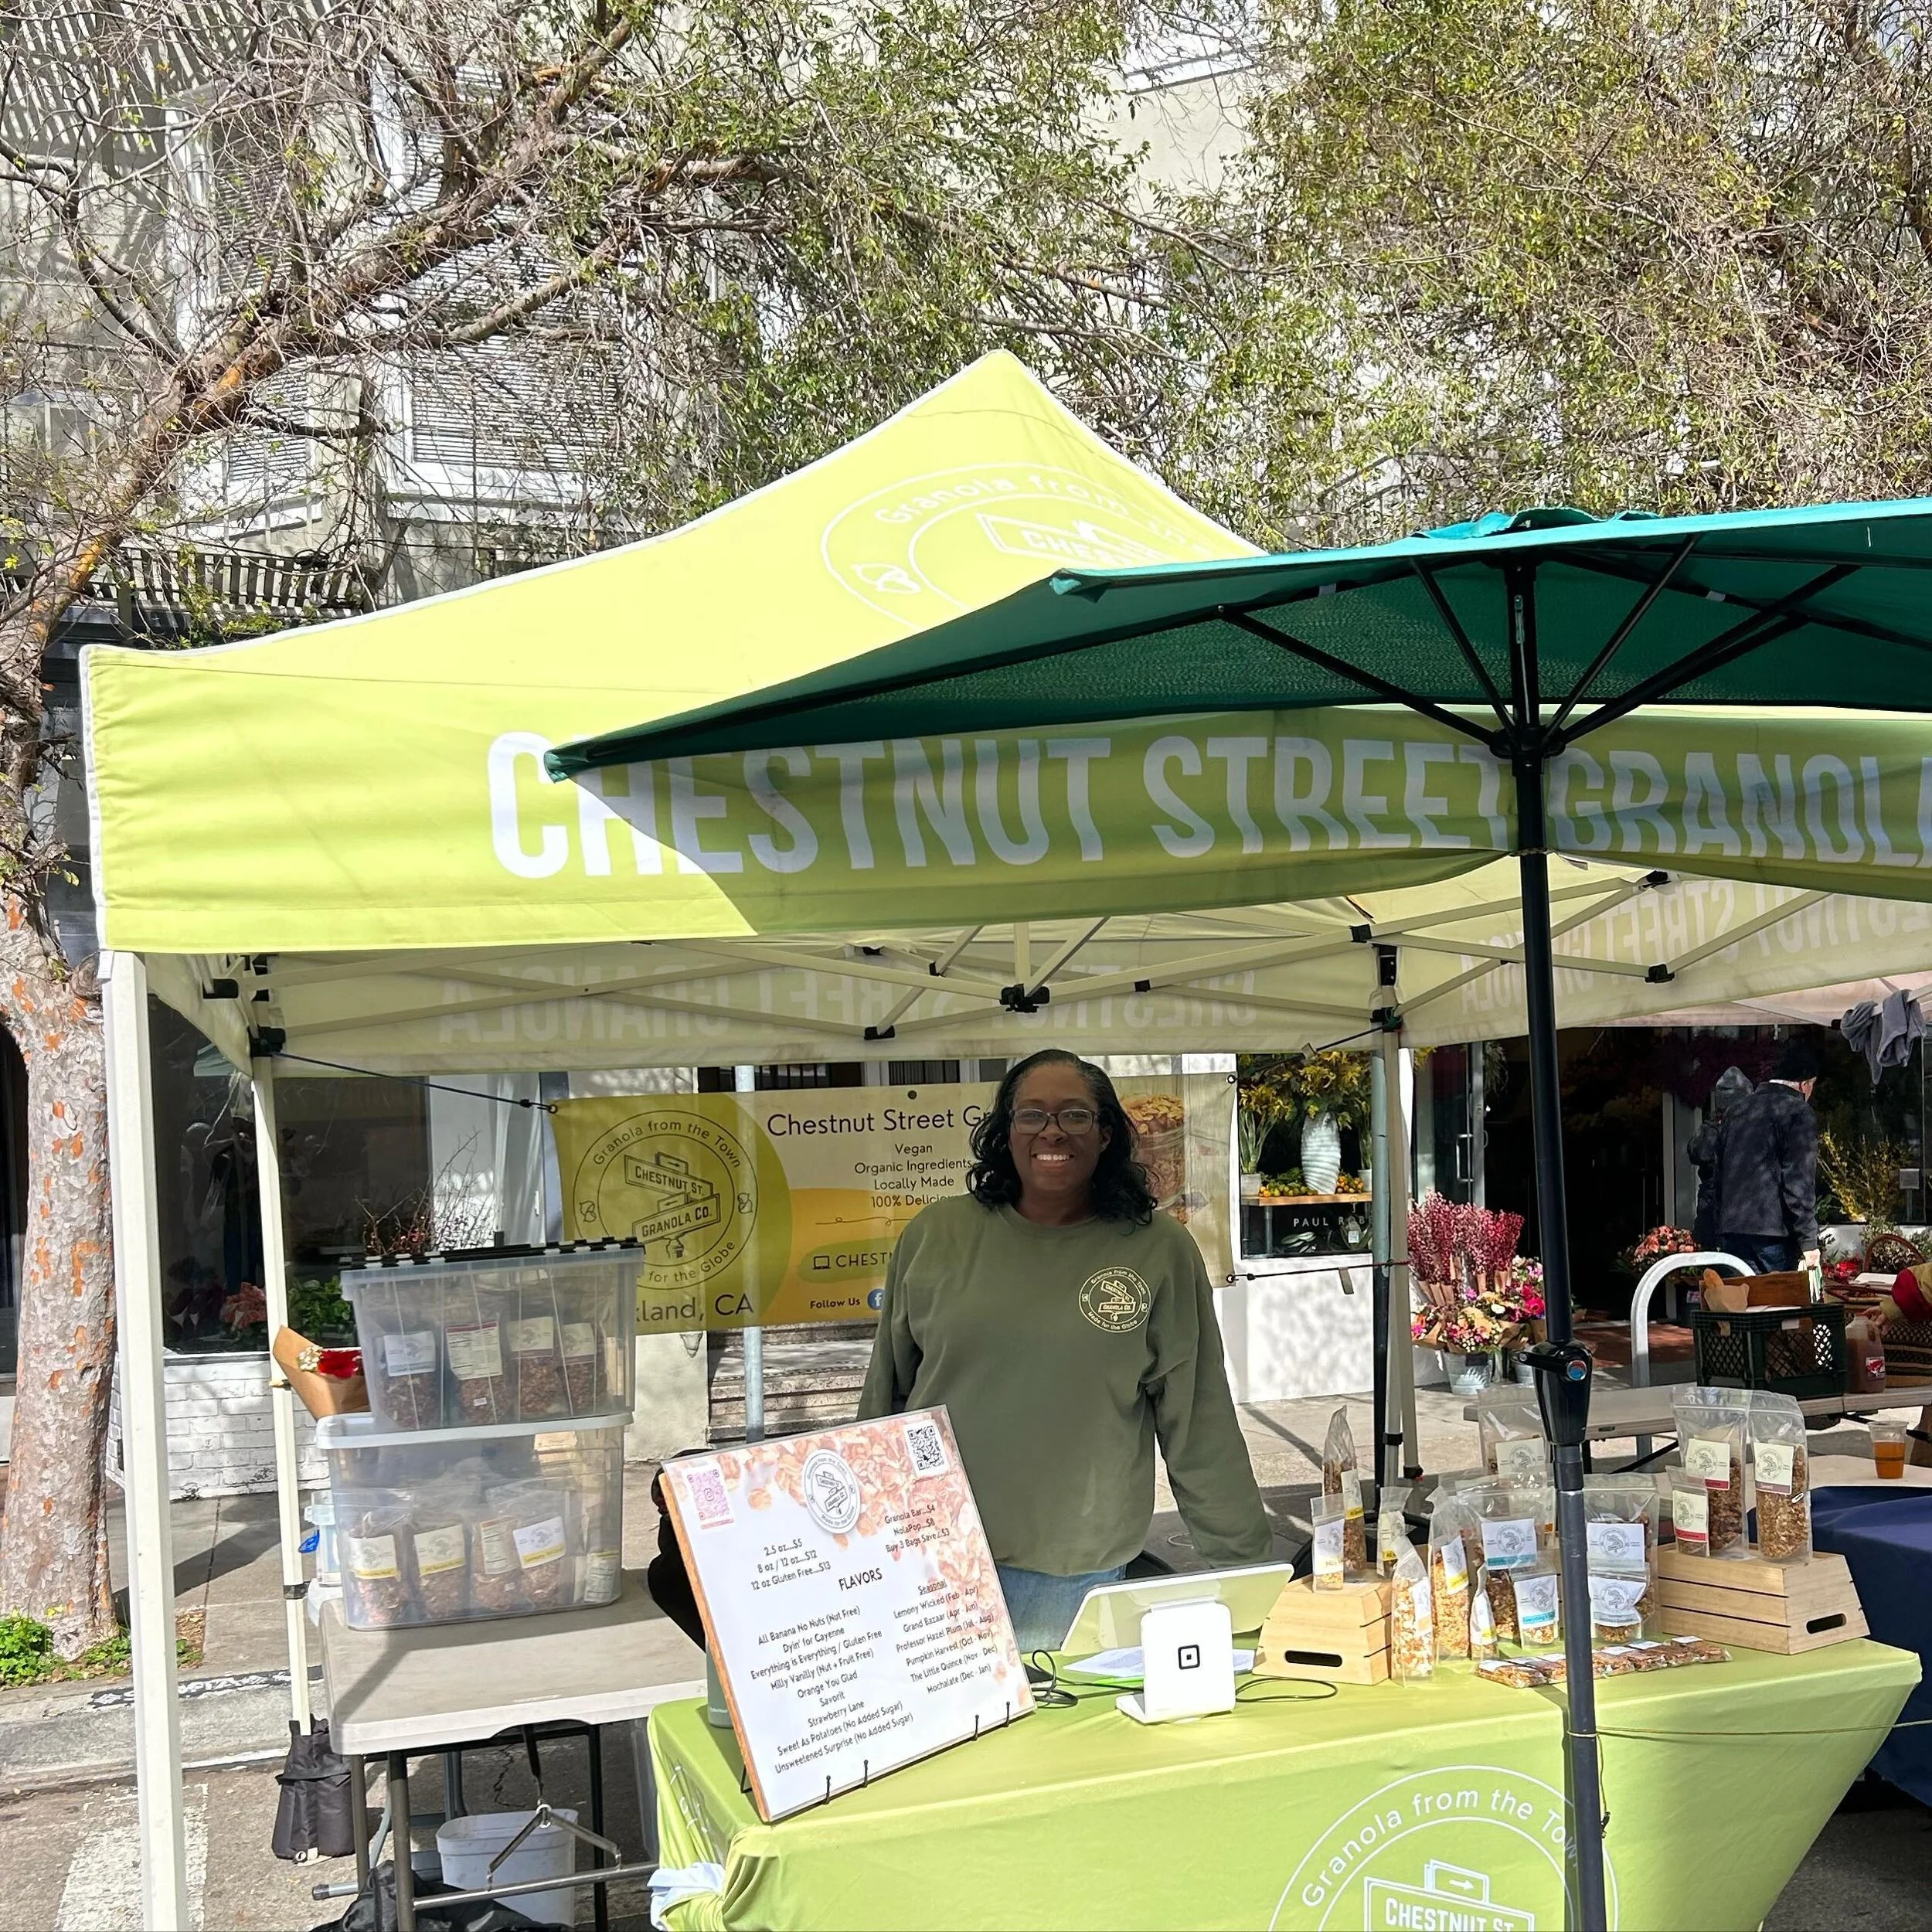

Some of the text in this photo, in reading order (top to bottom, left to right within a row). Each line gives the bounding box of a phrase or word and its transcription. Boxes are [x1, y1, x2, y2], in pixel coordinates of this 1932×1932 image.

[875, 474, 1129, 525] Granola from
[488, 731, 1111, 879] CHESTNUT
[1143, 736, 1515, 859] STREET
[767, 1113, 875, 1137] Chestnut
[884, 1108, 954, 1131] Street
[594, 1121, 741, 1168] Granola from the Town
[895, 1143, 933, 1157] Vegan
[634, 1165, 688, 1191] CHESTNUT
[855, 1158, 973, 1175] Organic Ingredients
[875, 1176, 954, 1191] Locally Made
[872, 1196, 902, 1208] 100%
[641, 1212, 692, 1237] GRANOLA
[1293, 1217, 1328, 1227] PAUL
[649, 1240, 736, 1283] for the Globe
[715, 1293, 753, 1316] CA
[810, 1298, 861, 1310] Follow Us
[884, 1512, 911, 1524] Granola
[764, 1545, 777, 1556] 2.5
[886, 1544, 899, 1553] Buy
[900, 1540, 904, 1549] 3
[905, 1538, 921, 1547] Bags
[921, 1533, 937, 1543] Save
[757, 1564, 763, 1573] 8
[764, 1563, 774, 1571] oz
[780, 1557, 789, 1567] 12
[838, 1567, 883, 1591] FLAVORS
[750, 1580, 760, 1590] 12
[761, 1580, 771, 1588] oz
[771, 1573, 797, 1585] Gluten
[917, 1578, 947, 1595] Seasonal
[893, 1605, 919, 1619] Lemony
[919, 1595, 945, 1610] Wicked
[945, 1593, 960, 1604] (Feb
[964, 1585, 979, 1596] Apr)
[757, 1605, 861, 1645] All Banana No Nuts (Nut Free)
[903, 1621, 923, 1633] Grand
[923, 1612, 945, 1625] Bazaar
[946, 1607, 960, 1619] (Apr
[966, 1600, 978, 1612] Jun)
[782, 1627, 845, 1653] Dyin' for Cayenne
[896, 1636, 926, 1653] Professor
[927, 1629, 945, 1641] Hazel
[946, 1624, 963, 1635] Plum
[964, 1619, 975, 1630] (Jul
[979, 1613, 994, 1624] Aug)
[750, 1660, 791, 1680] Everything
[791, 1658, 798, 1666] is
[798, 1645, 837, 1664] Everything
[843, 1634, 866, 1648] Gluten
[866, 1630, 883, 1641] Free
[906, 1651, 934, 1667] Pumpkin
[934, 1641, 958, 1655] Harvest
[959, 1636, 974, 1650] (Oct
[978, 1628, 994, 1639] Nov)
[770, 1678, 788, 1691] Milly
[789, 1669, 815, 1683] Vanilly
[816, 1662, 832, 1676] (Nut
[838, 1654, 855, 1667] Fruit
[855, 1648, 874, 1661] Free)
[910, 1672, 923, 1682] The
[923, 1666, 940, 1678] Little
[940, 1658, 963, 1672] Quince
[964, 1652, 978, 1664] (Nov
[982, 1644, 998, 1655] Dec)
[798, 1670, 858, 1699] Orange You Glad
[927, 1675, 959, 1694] Mochalate
[960, 1669, 975, 1682] (Dec
[978, 1663, 992, 1675] Jan)
[819, 1691, 845, 1707] Savorit
[808, 1700, 865, 1728] Strawberry Lane
[777, 1700, 903, 1757] Sweet As Potatoes (No Added Sugar)
[775, 1712, 913, 1774] Unsweetened Surprise (No Added Sugar)
[1301, 1788, 1577, 1907] Granola from the Tow
